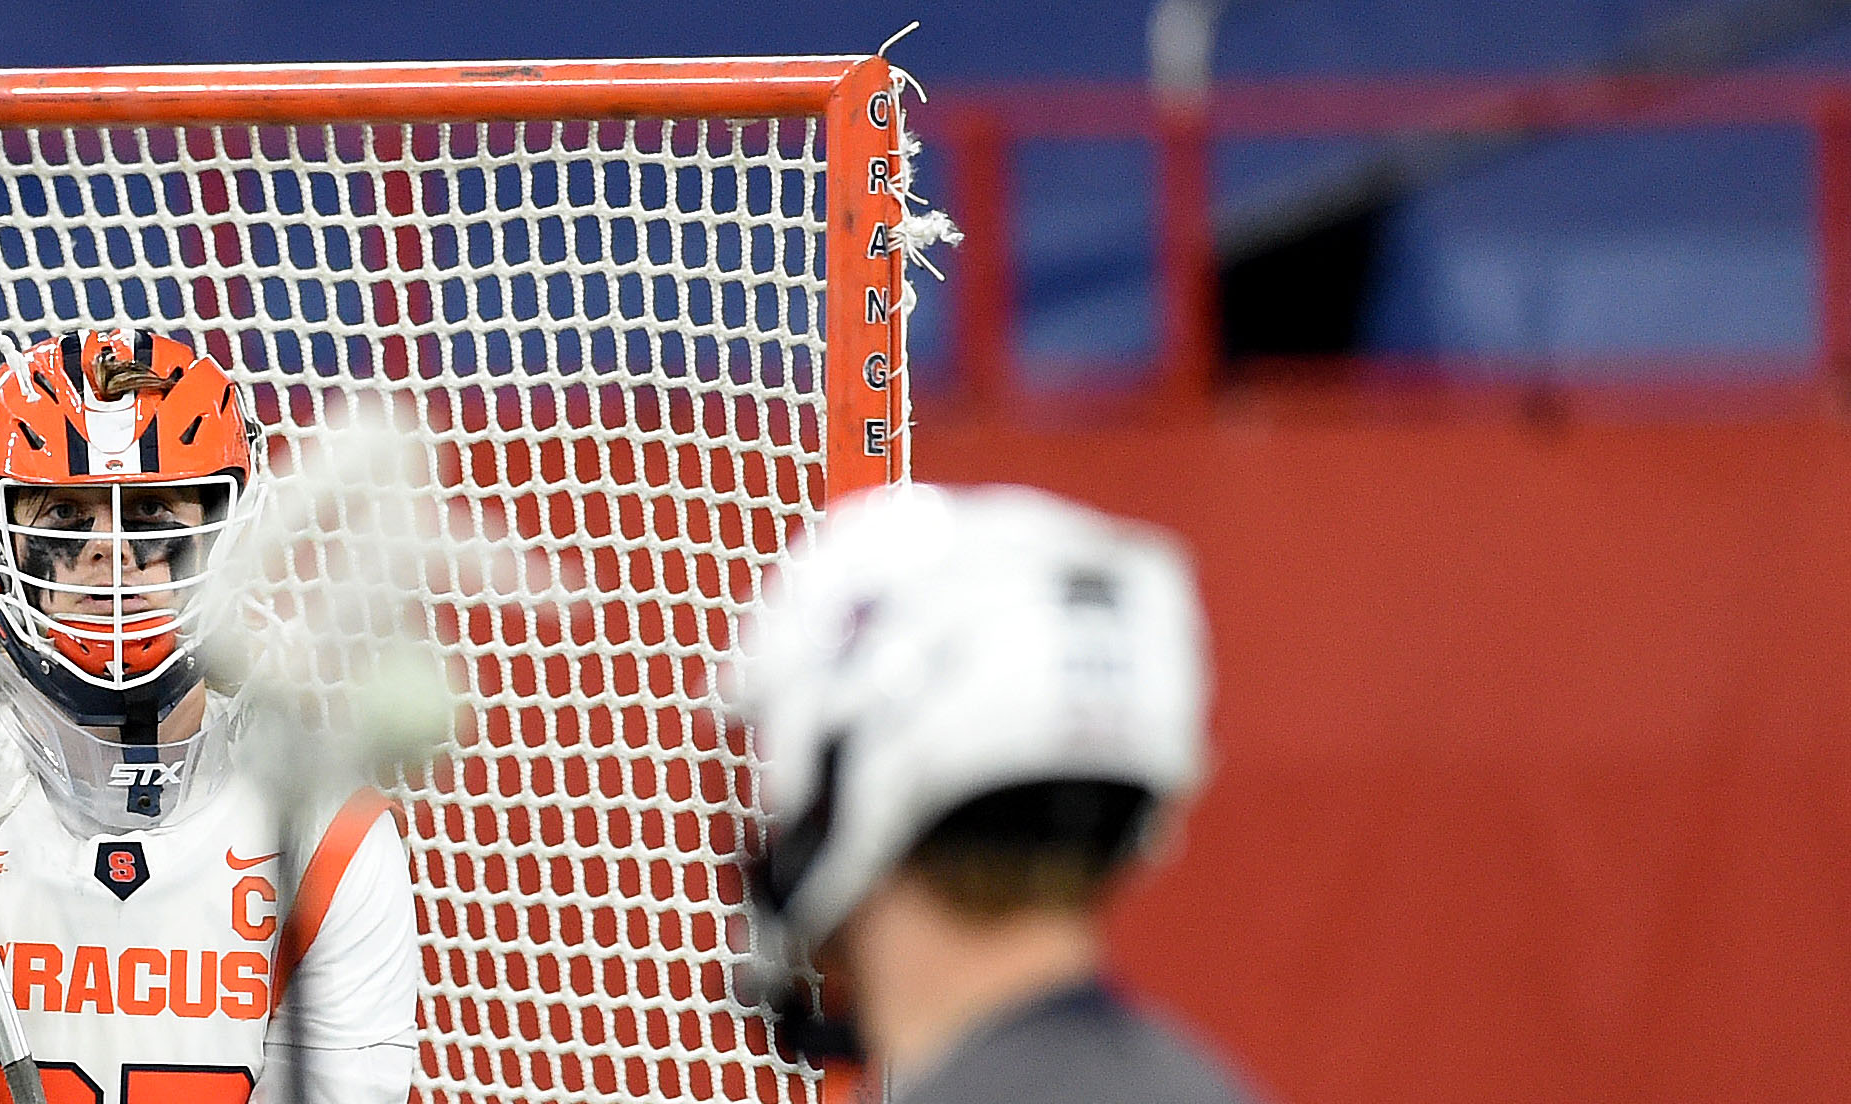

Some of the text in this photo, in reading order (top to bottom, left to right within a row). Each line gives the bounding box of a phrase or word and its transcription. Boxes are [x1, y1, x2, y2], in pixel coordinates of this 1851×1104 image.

[863, 92, 890, 456] ORANGE
[108, 760, 186, 786] STX
[108, 851, 136, 883] S
[231, 875, 277, 942] C
